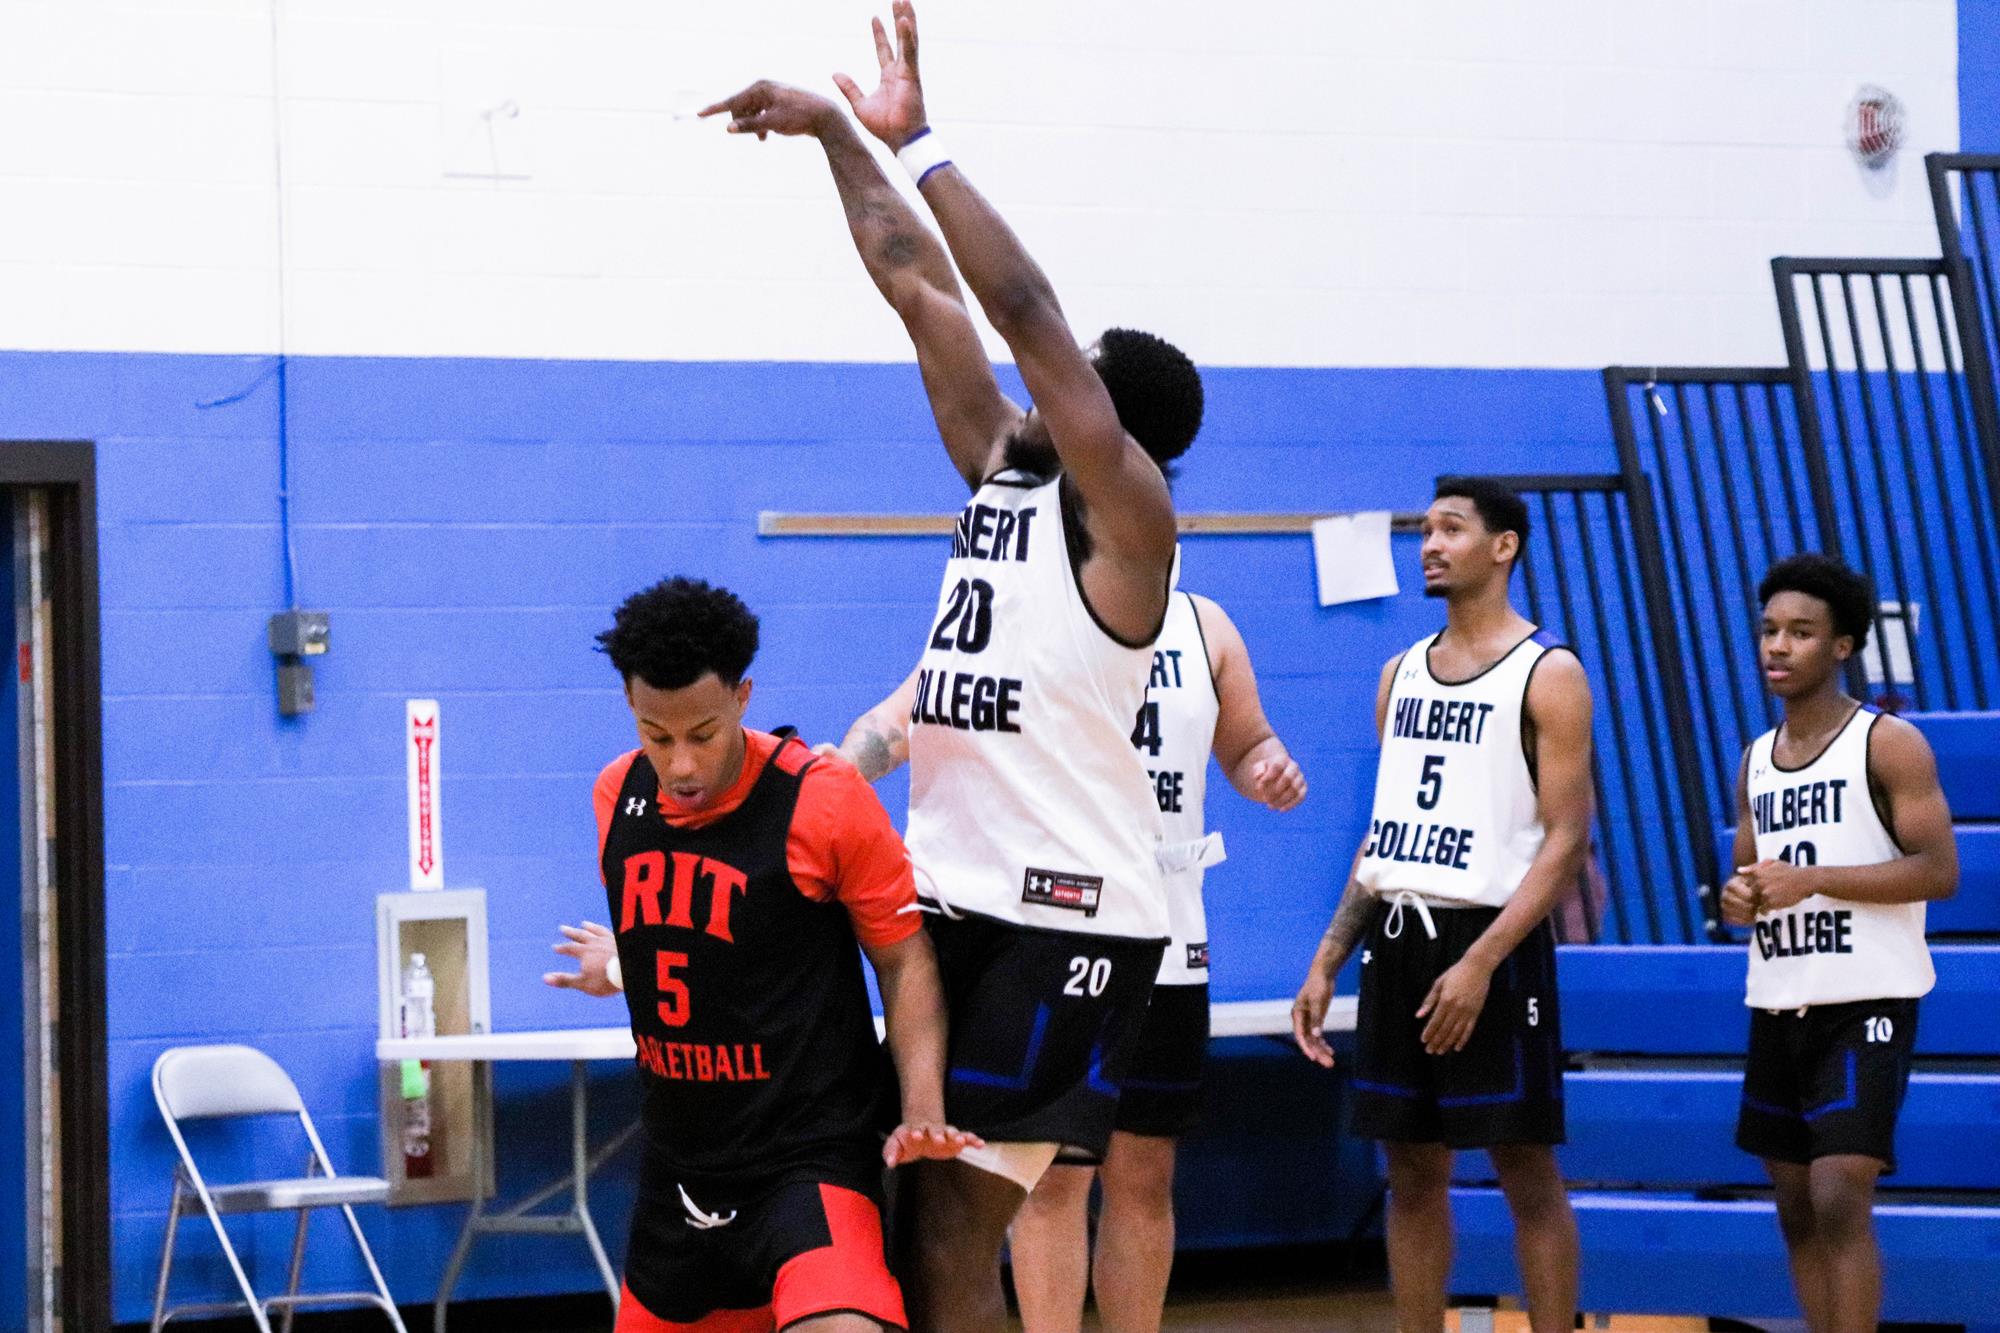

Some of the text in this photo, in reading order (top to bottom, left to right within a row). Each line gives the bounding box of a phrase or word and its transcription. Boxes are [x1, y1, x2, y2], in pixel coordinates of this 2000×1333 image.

[930, 577, 995, 655] 20
[909, 668, 1023, 734] OLLEGE
[1393, 697, 1494, 744] HILBERT
[1416, 755, 1446, 811] 5
[1753, 779, 1847, 836] HILBERT
[619, 850, 748, 945] RIT
[656, 950, 691, 1028] 5
[1063, 955, 1113, 998] 20
[1527, 997, 1539, 1027] 5
[1863, 1015, 1894, 1043] 10
[636, 1032, 772, 1082] ASKETBALL
